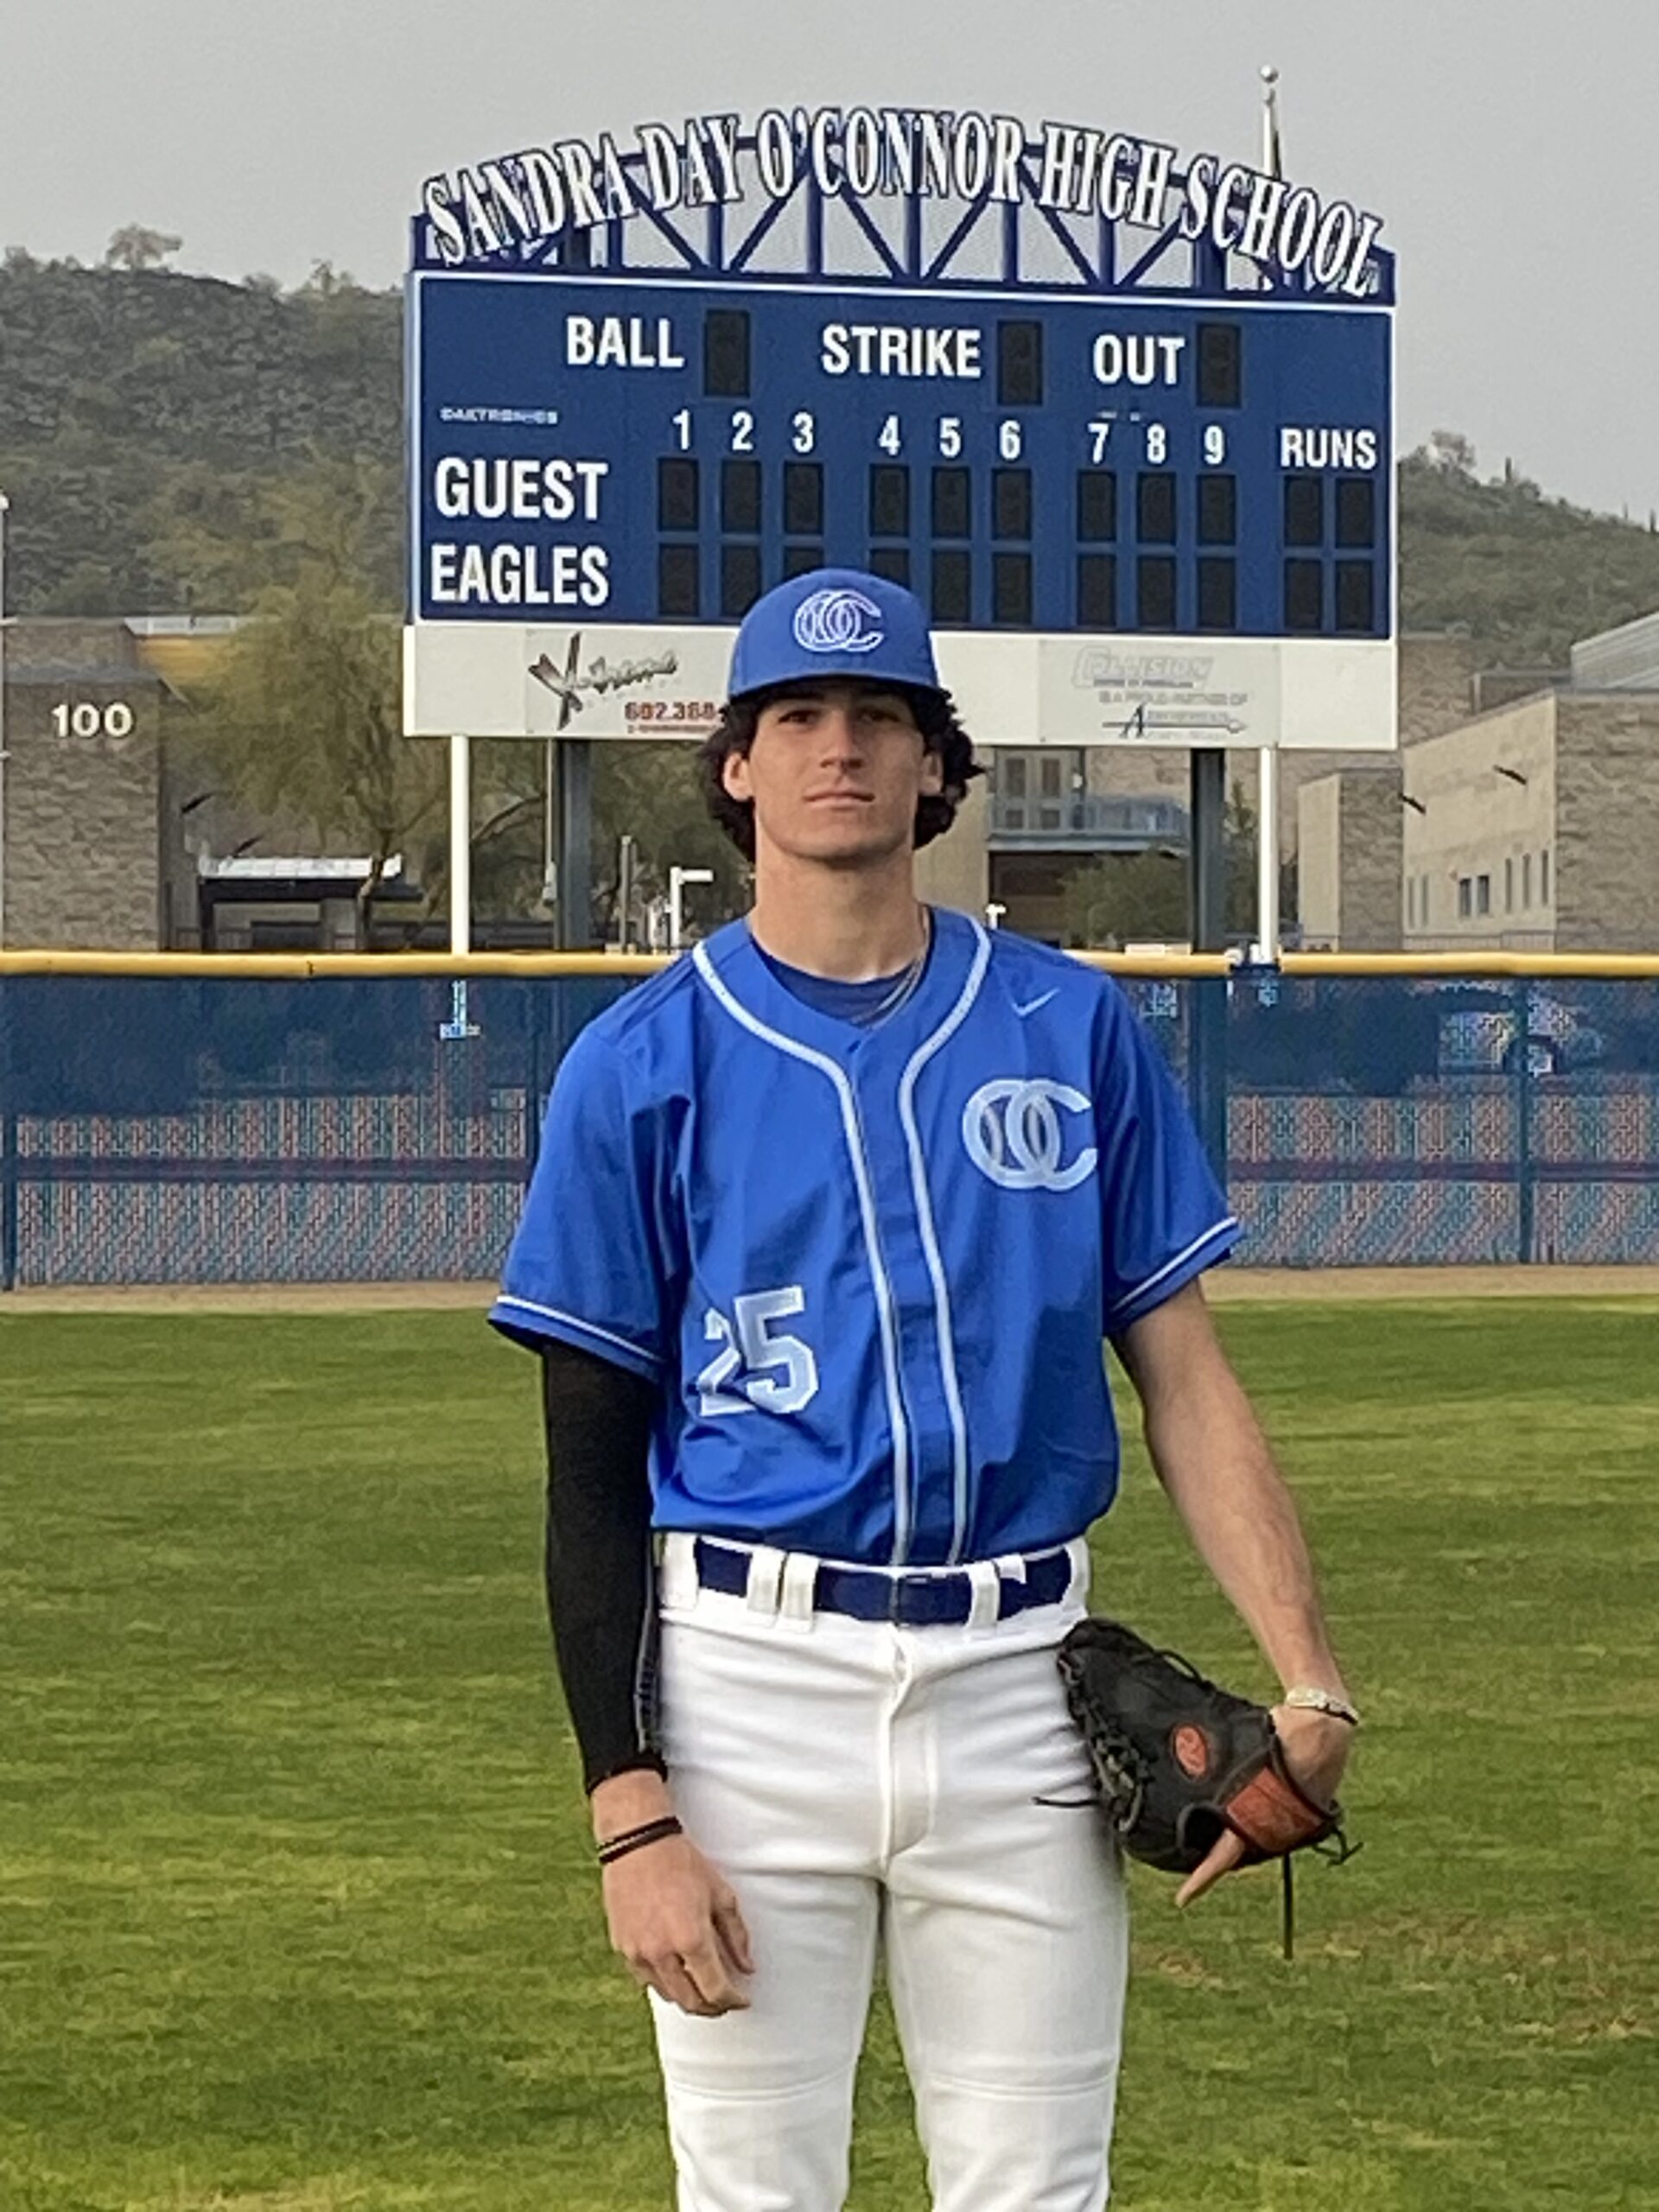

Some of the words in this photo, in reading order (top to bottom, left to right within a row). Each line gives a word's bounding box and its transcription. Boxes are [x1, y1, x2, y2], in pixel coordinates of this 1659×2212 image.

[423, 132, 639, 265] SANDRA
[635, 113, 743, 212] DAY
[757, 107, 1026, 204] O'CONNOR
[1037, 119, 1178, 231] HIGH
[1179, 153, 1383, 299] SCHOOL
[566, 316, 685, 368] BALL
[821, 324, 982, 378] STRIKE
[1092, 334, 1186, 385] OUT
[673, 410, 690, 450] 1
[732, 411, 753, 451] 2
[792, 412, 813, 454] 3
[879, 416, 900, 456] 4
[940, 417, 961, 458] 5
[1000, 420, 1020, 460] 6
[1088, 422, 1109, 463] 7
[1147, 423, 1166, 464] 8
[1205, 425, 1224, 465] 9
[1280, 428, 1377, 470] RUNS
[435, 457, 608, 520] GUEST
[430, 543, 609, 607] EAGLES
[51, 702, 134, 738] 100
[696, 1284, 819, 1417] 25
